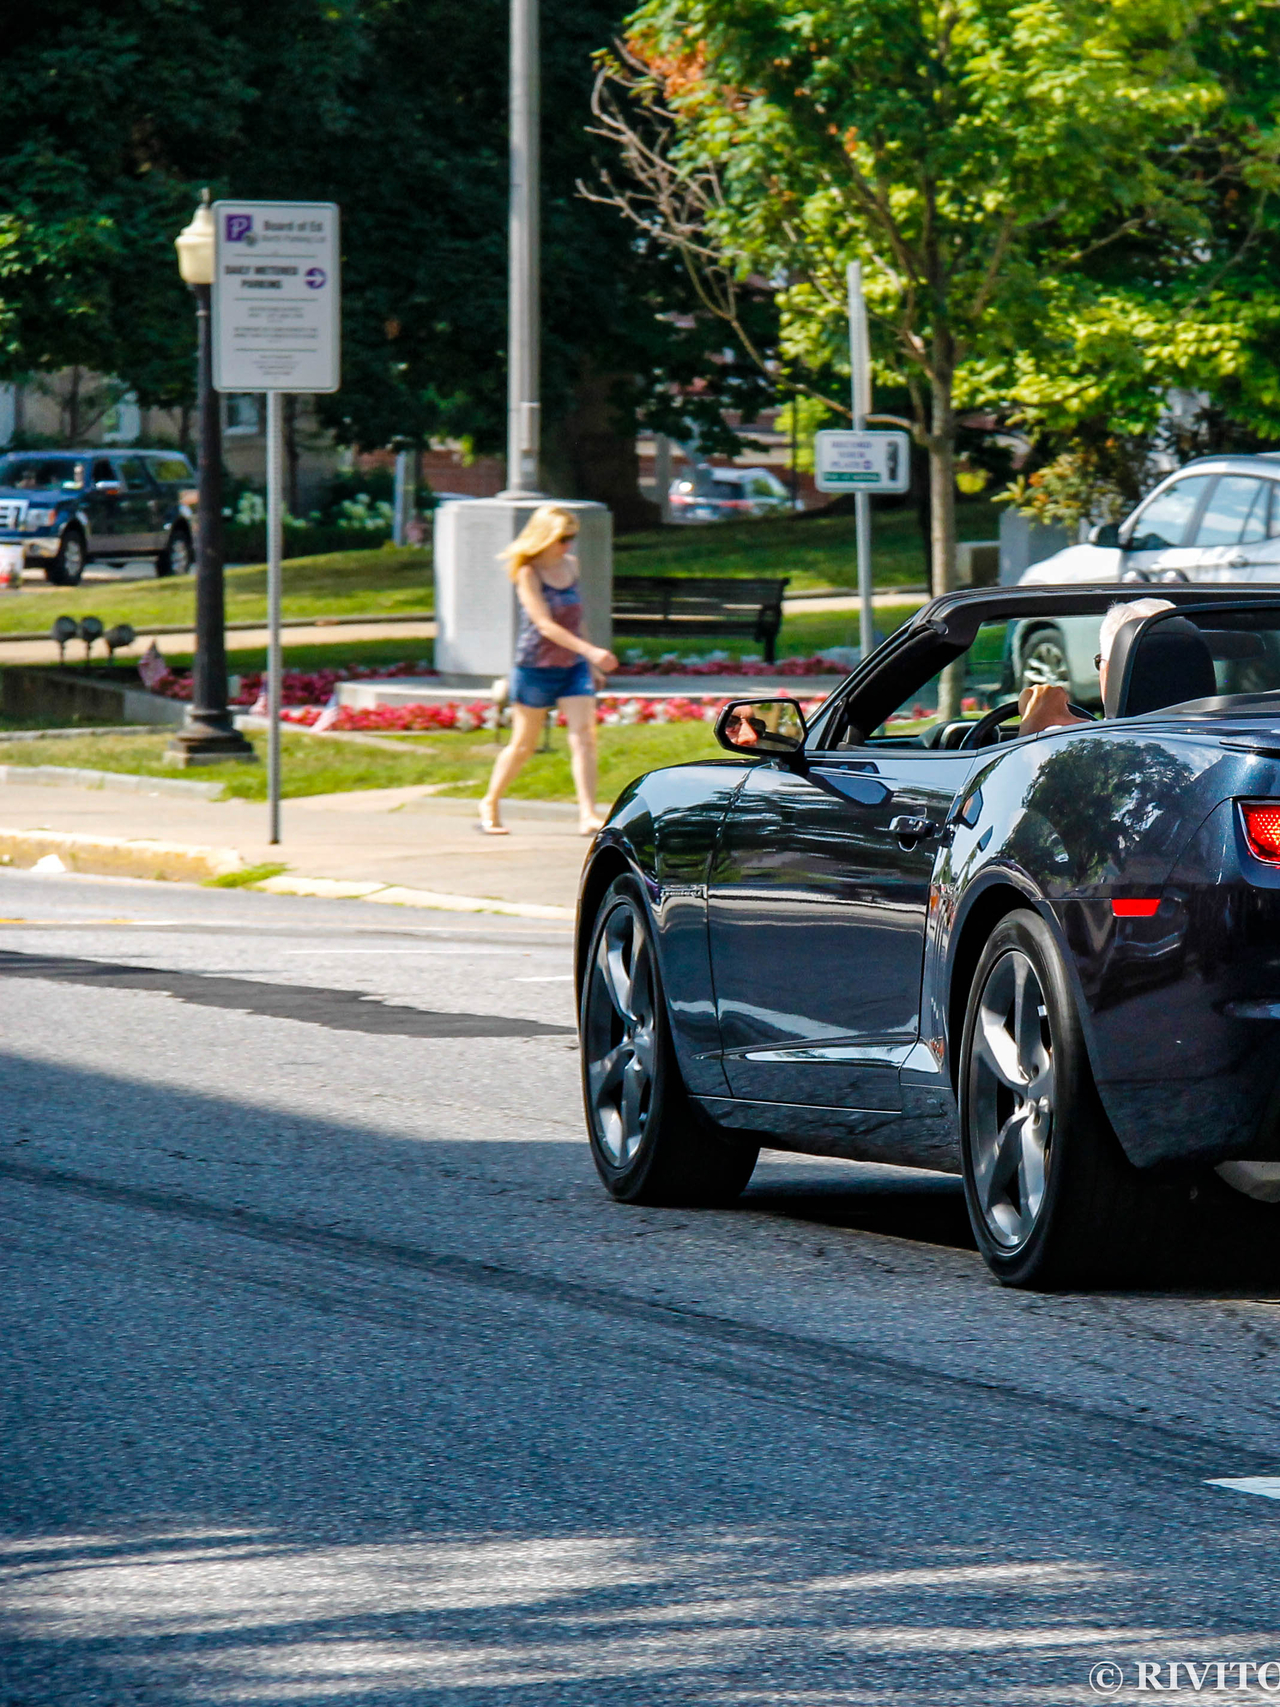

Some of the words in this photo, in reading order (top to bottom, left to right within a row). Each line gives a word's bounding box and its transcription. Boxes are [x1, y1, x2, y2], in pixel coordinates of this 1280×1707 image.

[263, 220, 294, 232] Board
[297, 220, 307, 232] of
[225, 266, 250, 275] DAILY
[254, 266, 298, 275] METERED
[241, 280, 282, 289] PARKING
